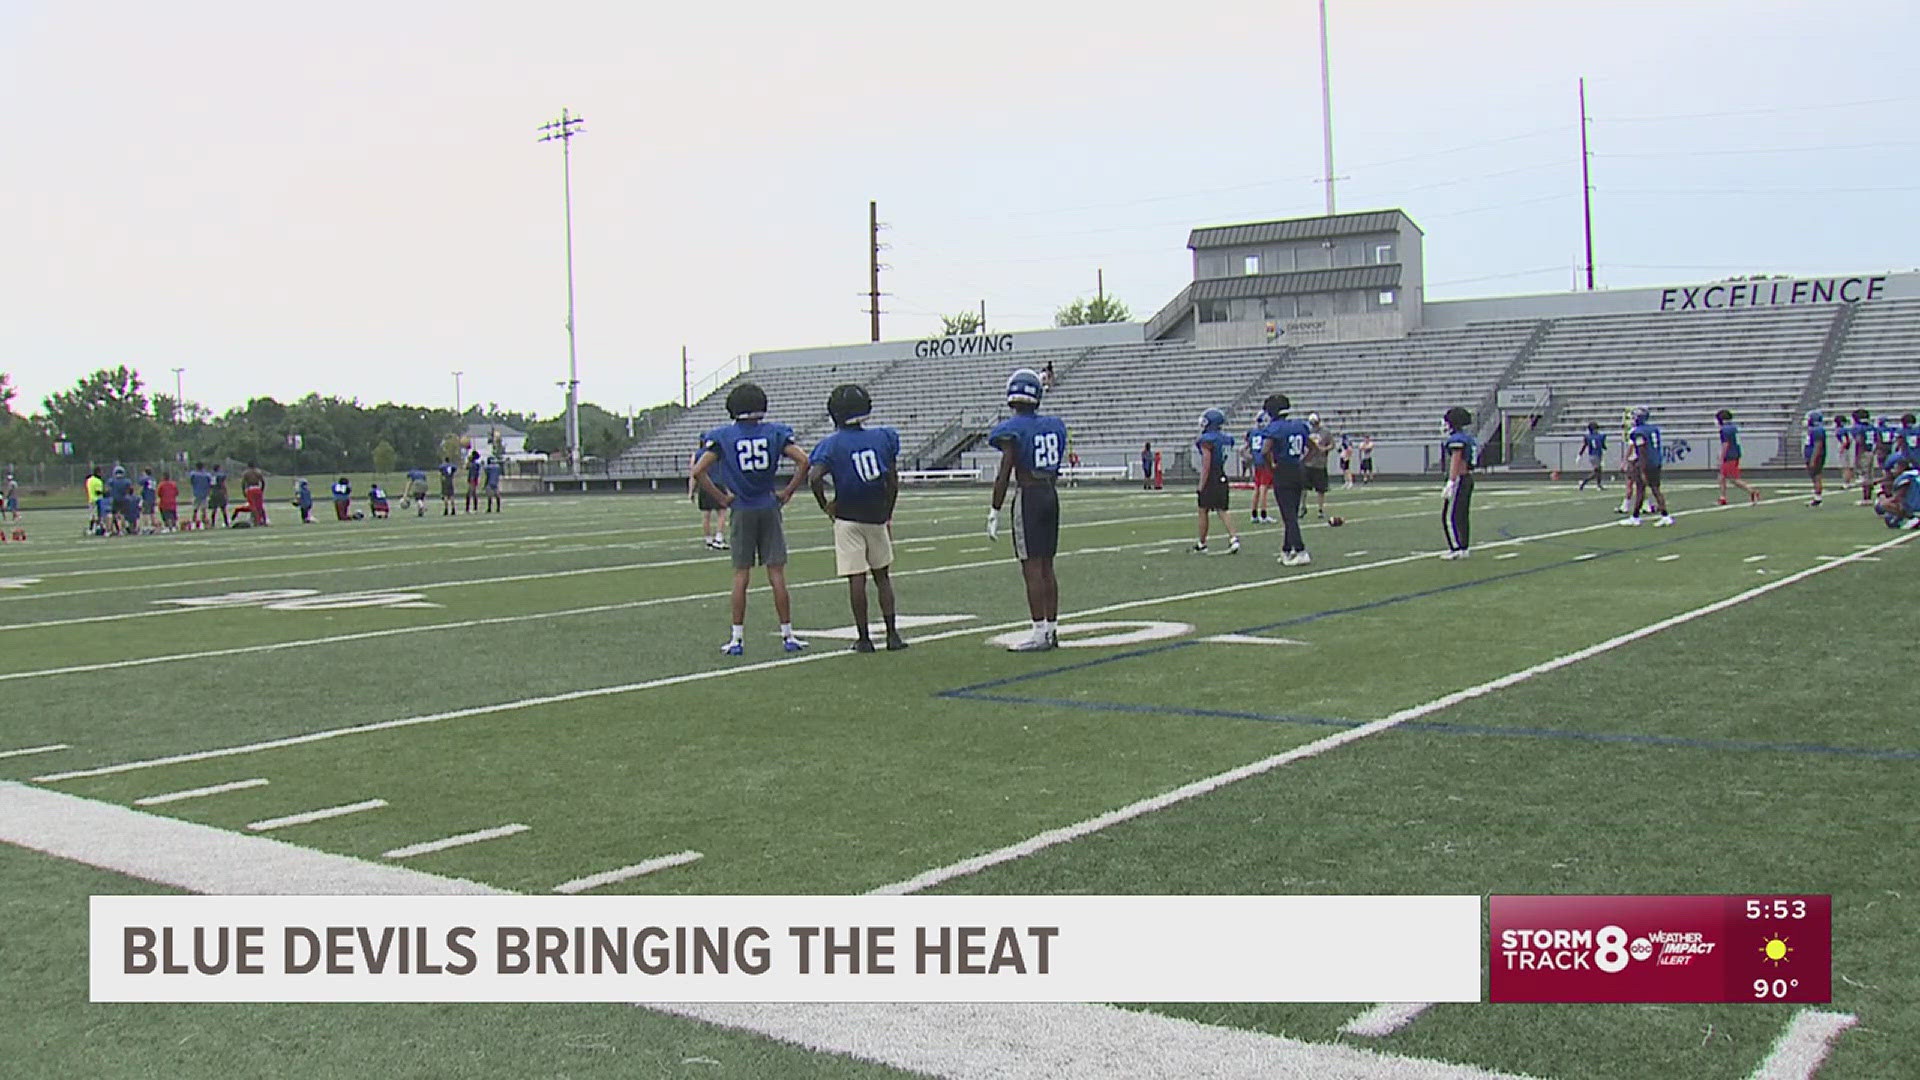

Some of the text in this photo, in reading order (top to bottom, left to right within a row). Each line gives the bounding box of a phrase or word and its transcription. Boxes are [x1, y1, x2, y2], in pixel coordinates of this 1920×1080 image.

[1660, 277, 1886, 311] EXCELLENCE
[915, 334, 1013, 357] GROWING
[736, 438, 770, 471] 25
[851, 449, 881, 482] 10
[1033, 433, 1060, 467] 28
